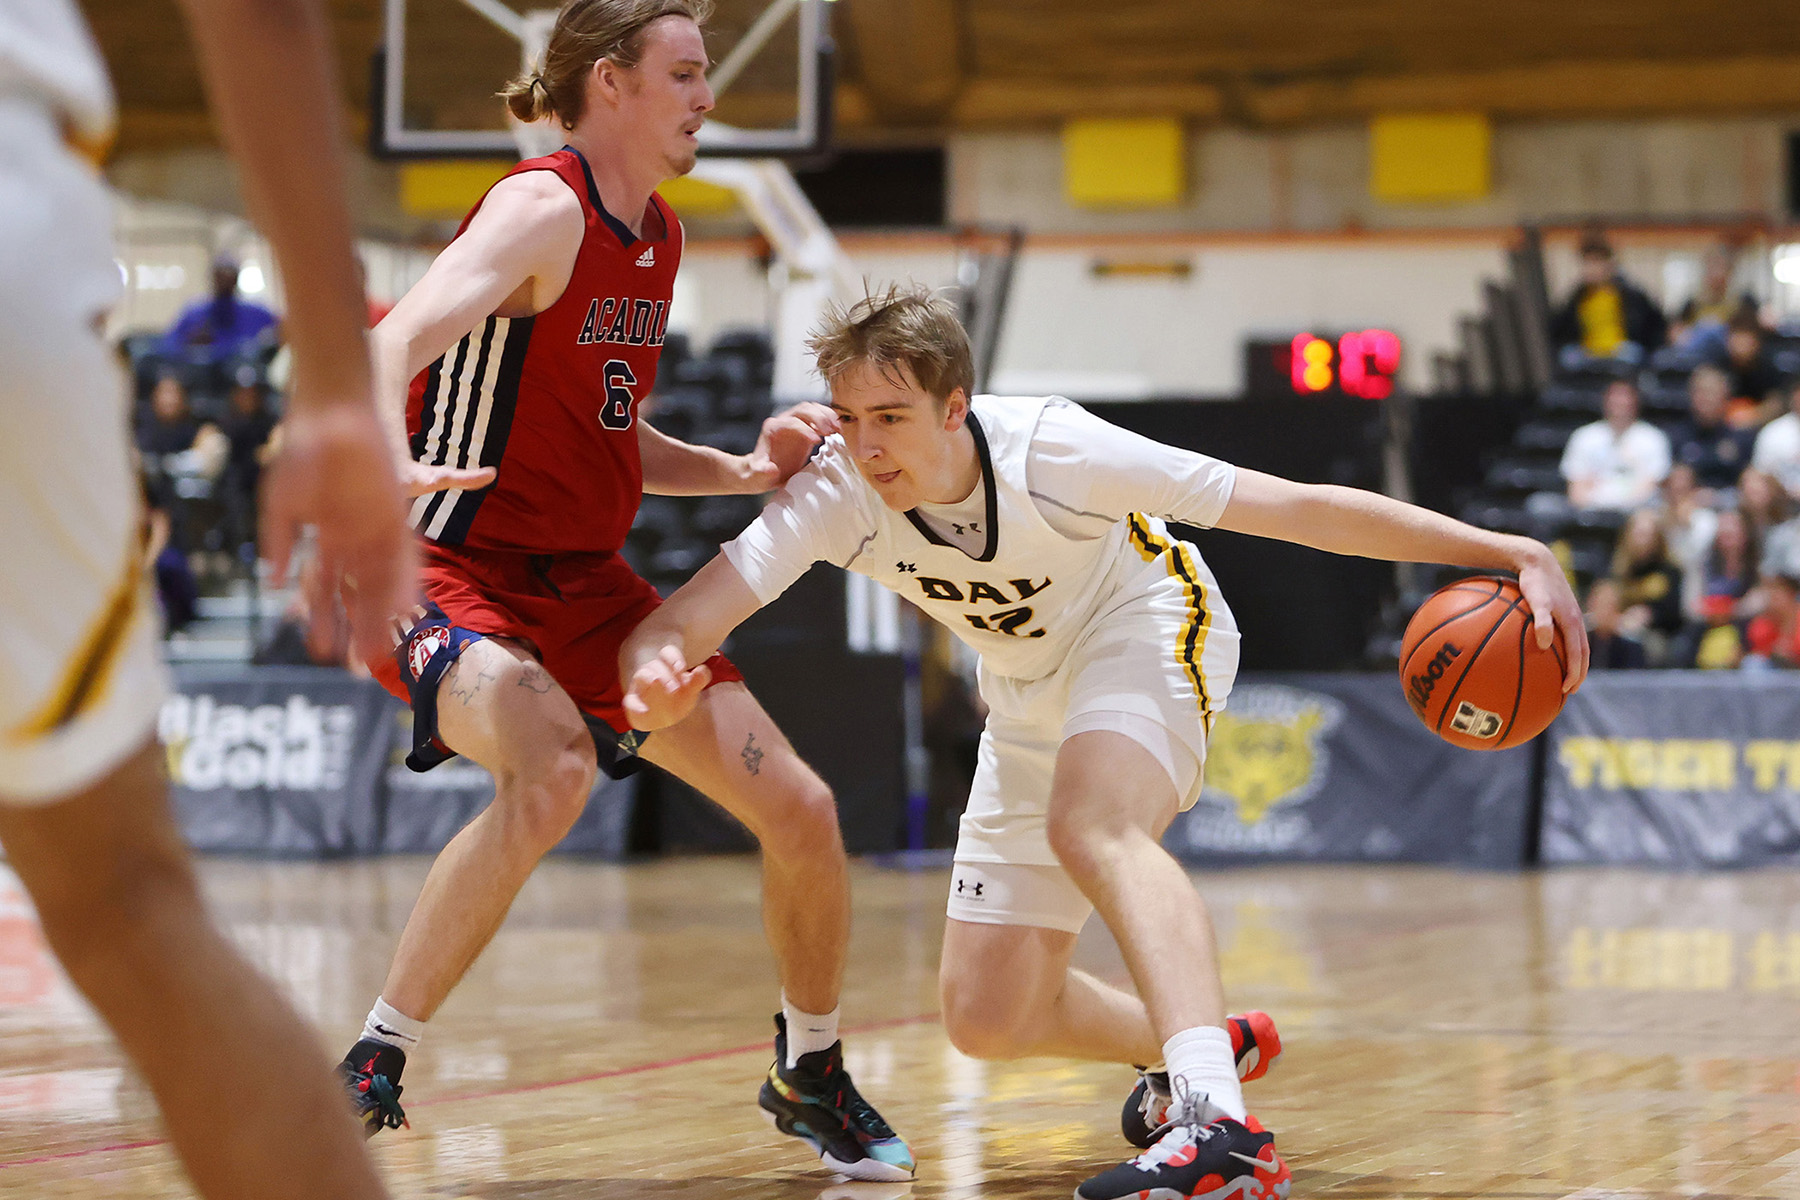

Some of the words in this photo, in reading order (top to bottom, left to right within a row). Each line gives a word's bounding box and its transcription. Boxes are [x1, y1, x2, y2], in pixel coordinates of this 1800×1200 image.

[598, 359, 638, 431] 6
[914, 576, 1053, 605] DAL
[963, 606, 1047, 638] 12
[1408, 642, 1463, 721] ilson
